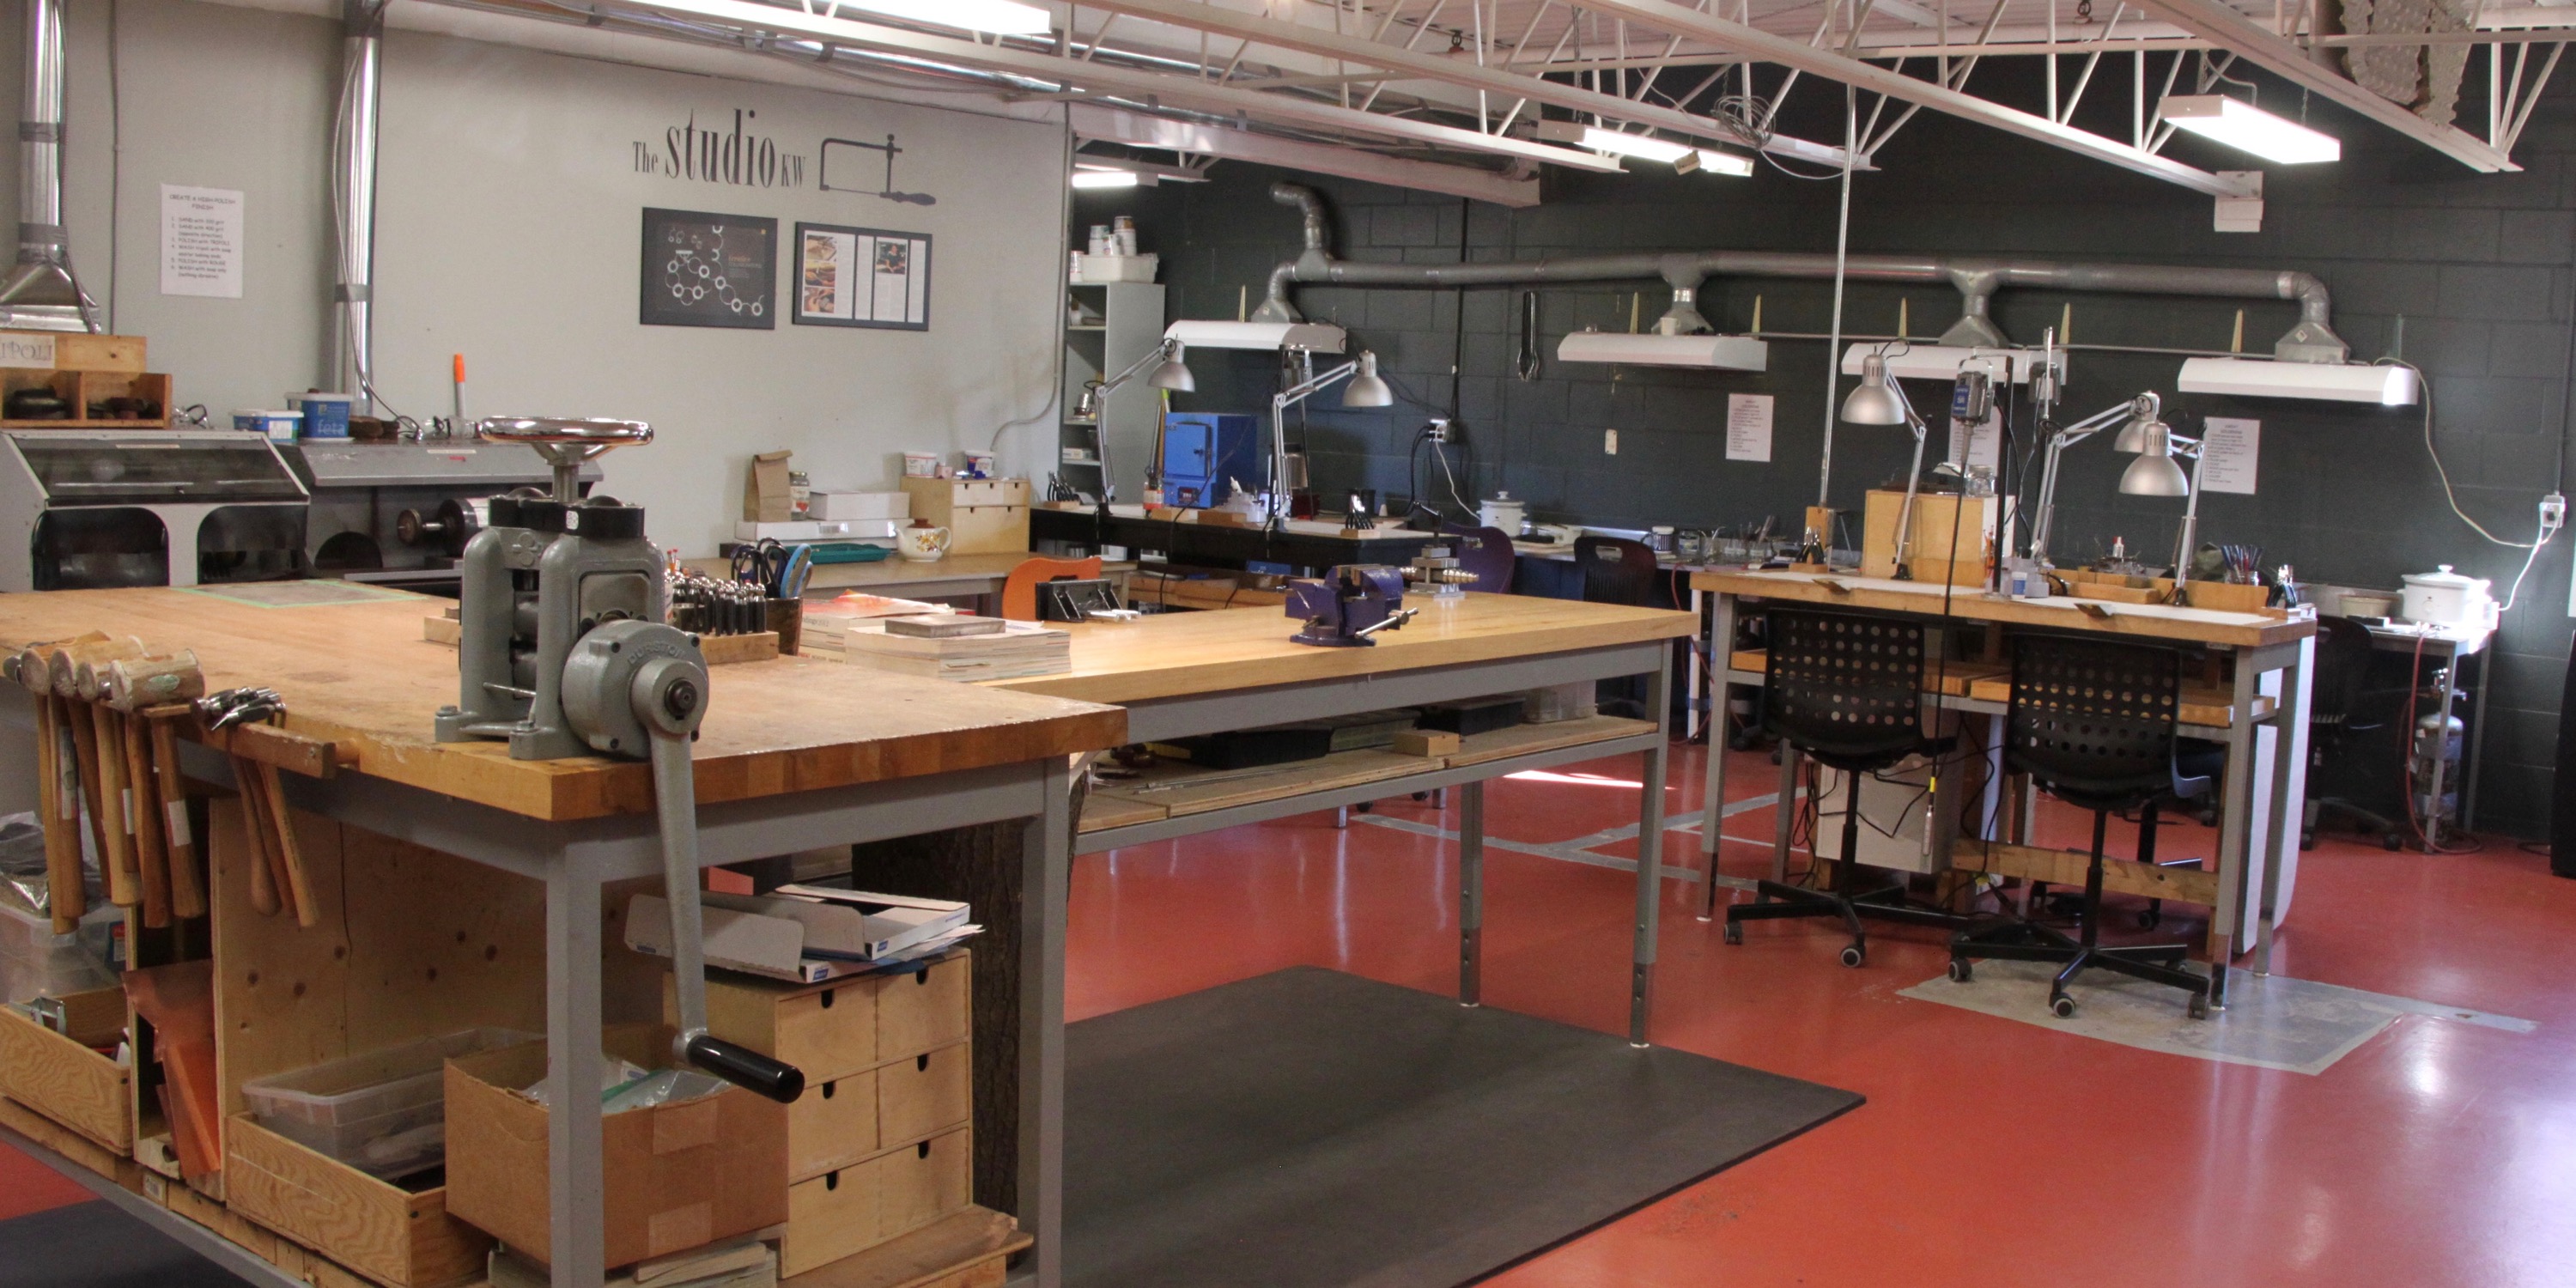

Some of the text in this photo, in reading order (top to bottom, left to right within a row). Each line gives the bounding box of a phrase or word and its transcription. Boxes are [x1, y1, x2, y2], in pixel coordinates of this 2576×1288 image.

[632, 107, 806, 188] The studio KW
[318, 419, 345, 435] feta
